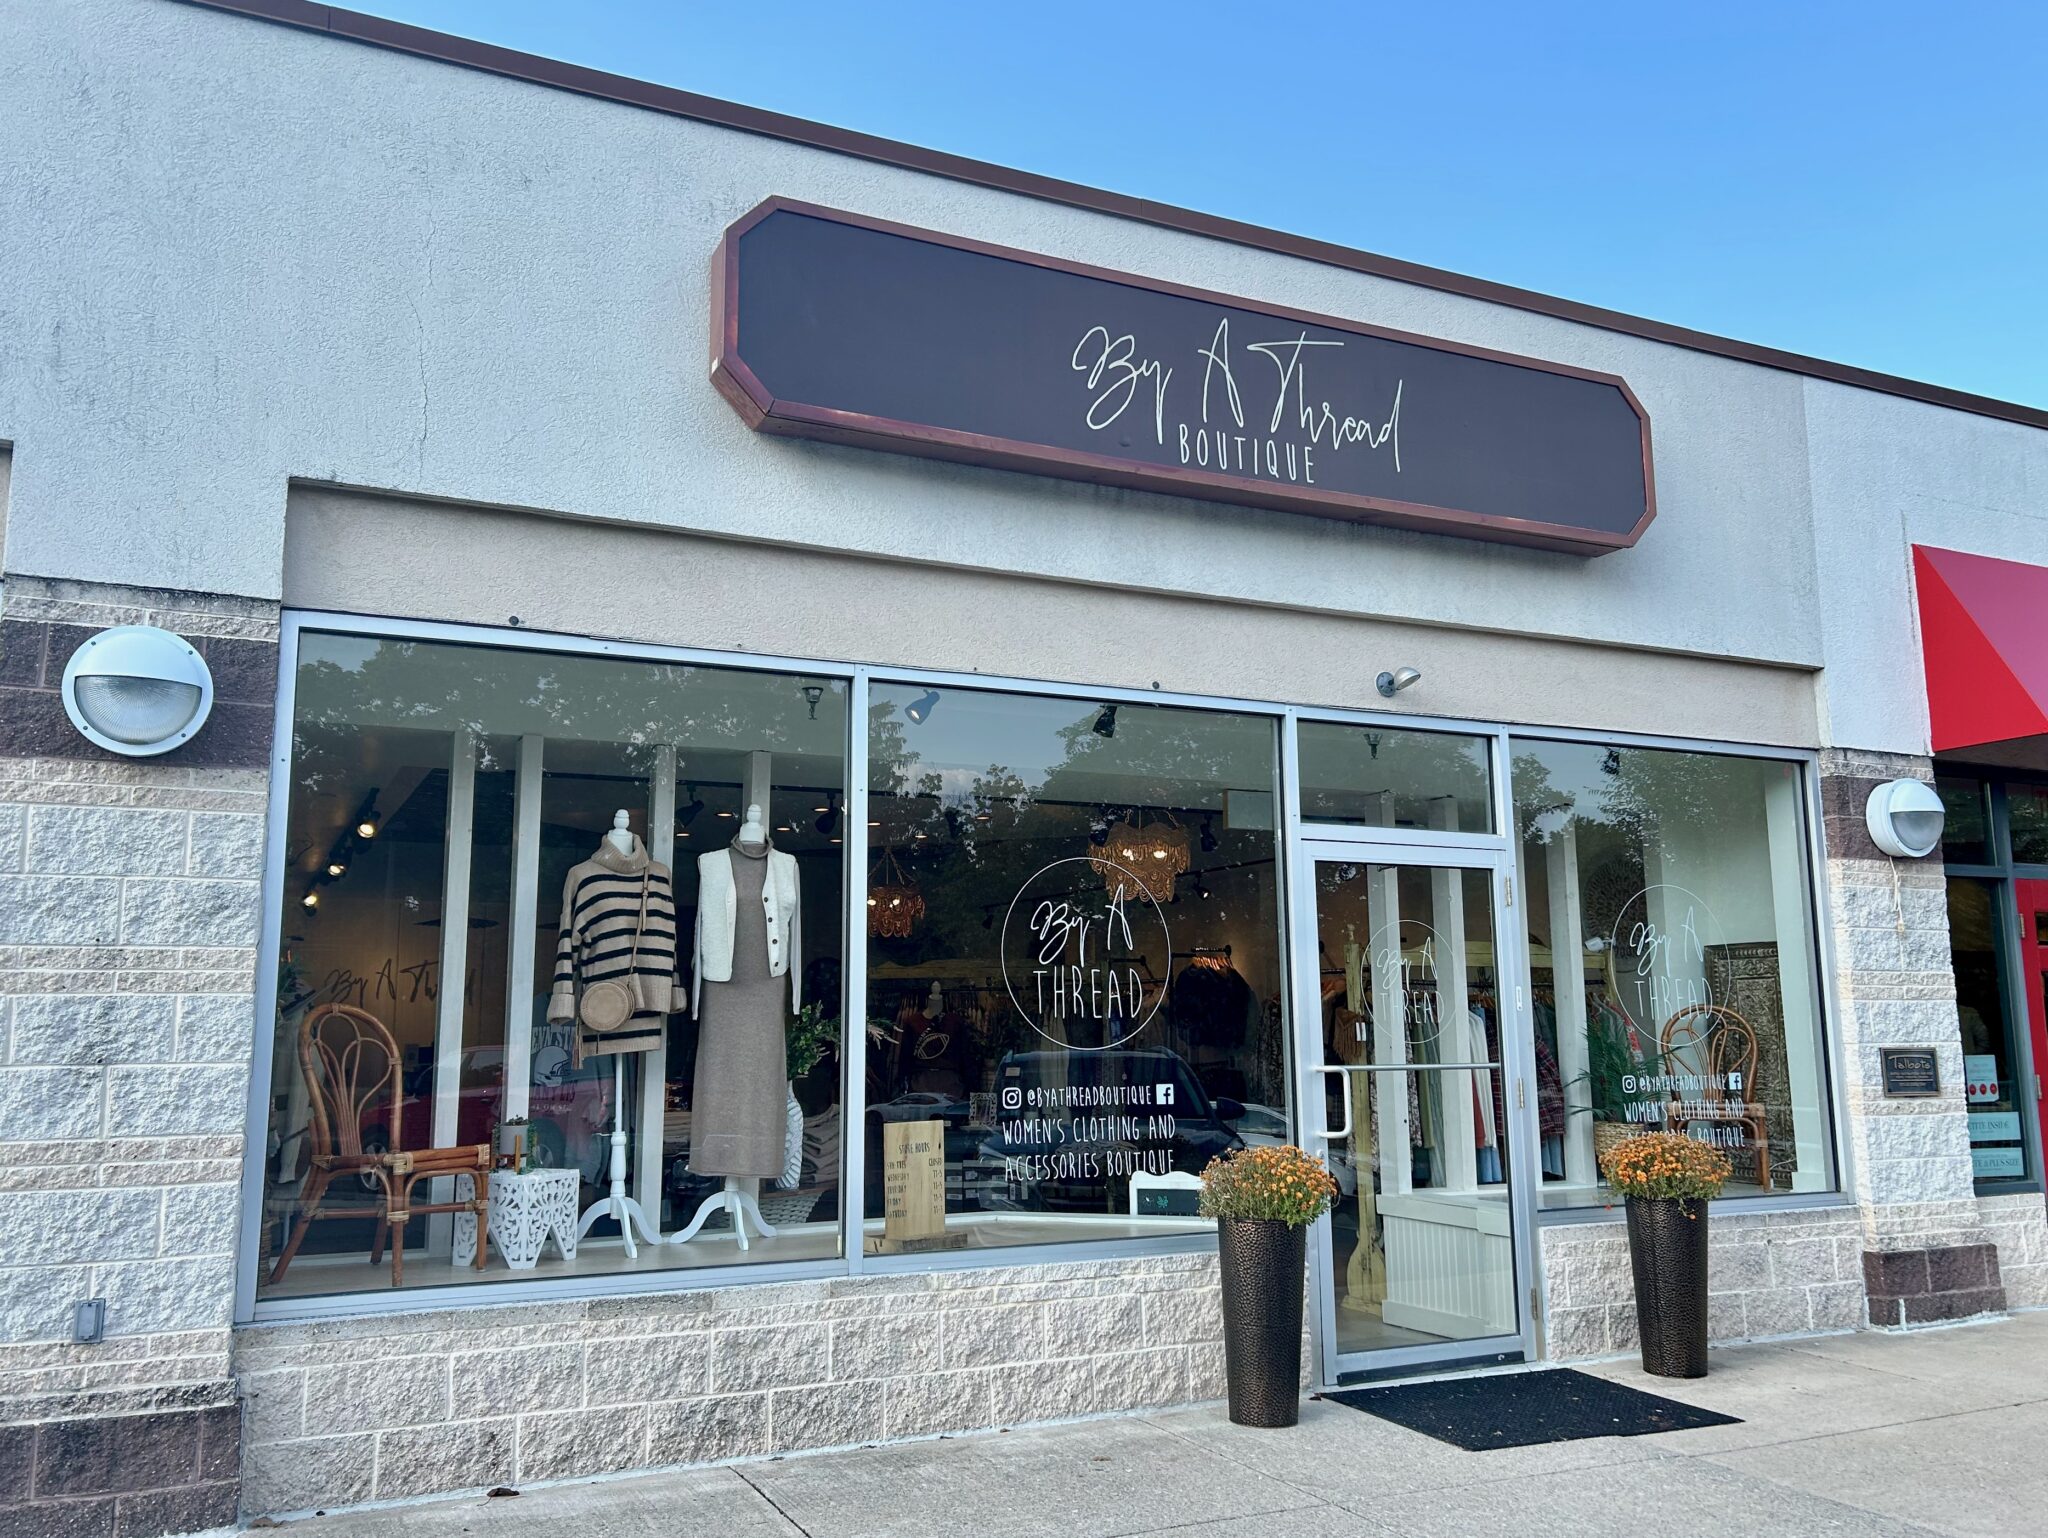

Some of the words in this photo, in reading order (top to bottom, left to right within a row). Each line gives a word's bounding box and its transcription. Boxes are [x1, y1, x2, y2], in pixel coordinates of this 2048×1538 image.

[1072, 326, 1172, 444] By
[1198, 317, 1243, 428] A
[1247, 331, 1402, 472] Thread
[1179, 424, 1314, 483] BOUTIQUE
[1031, 901, 1090, 968] By
[1105, 884, 1133, 951] A
[1629, 922, 1671, 977] By
[1680, 906, 1704, 962] A
[1377, 948, 1411, 992] By
[1420, 936, 1438, 980] A
[1033, 965, 1143, 1020] THREAD
[1380, 989, 1445, 1024] THREAD
[1634, 976, 1713, 1021] THREAD
[1888, 1054, 1932, 1070] Talbots
[1027, 1084, 1151, 1107] @BYATHREADBOUTIQUE
[1623, 1101, 1668, 1122] WOMEN'S
[1672, 1098, 1720, 1121] CLOTHING
[1725, 1098, 1745, 1118] AND
[1003, 1118, 1065, 1145] WOMEN'S
[1073, 1115, 1140, 1143] CLOTHING
[1149, 1114, 1176, 1139] AND
[1005, 1152, 1099, 1181] ACCESSORIES
[1107, 1149, 1174, 1176] BOUTIQUE
